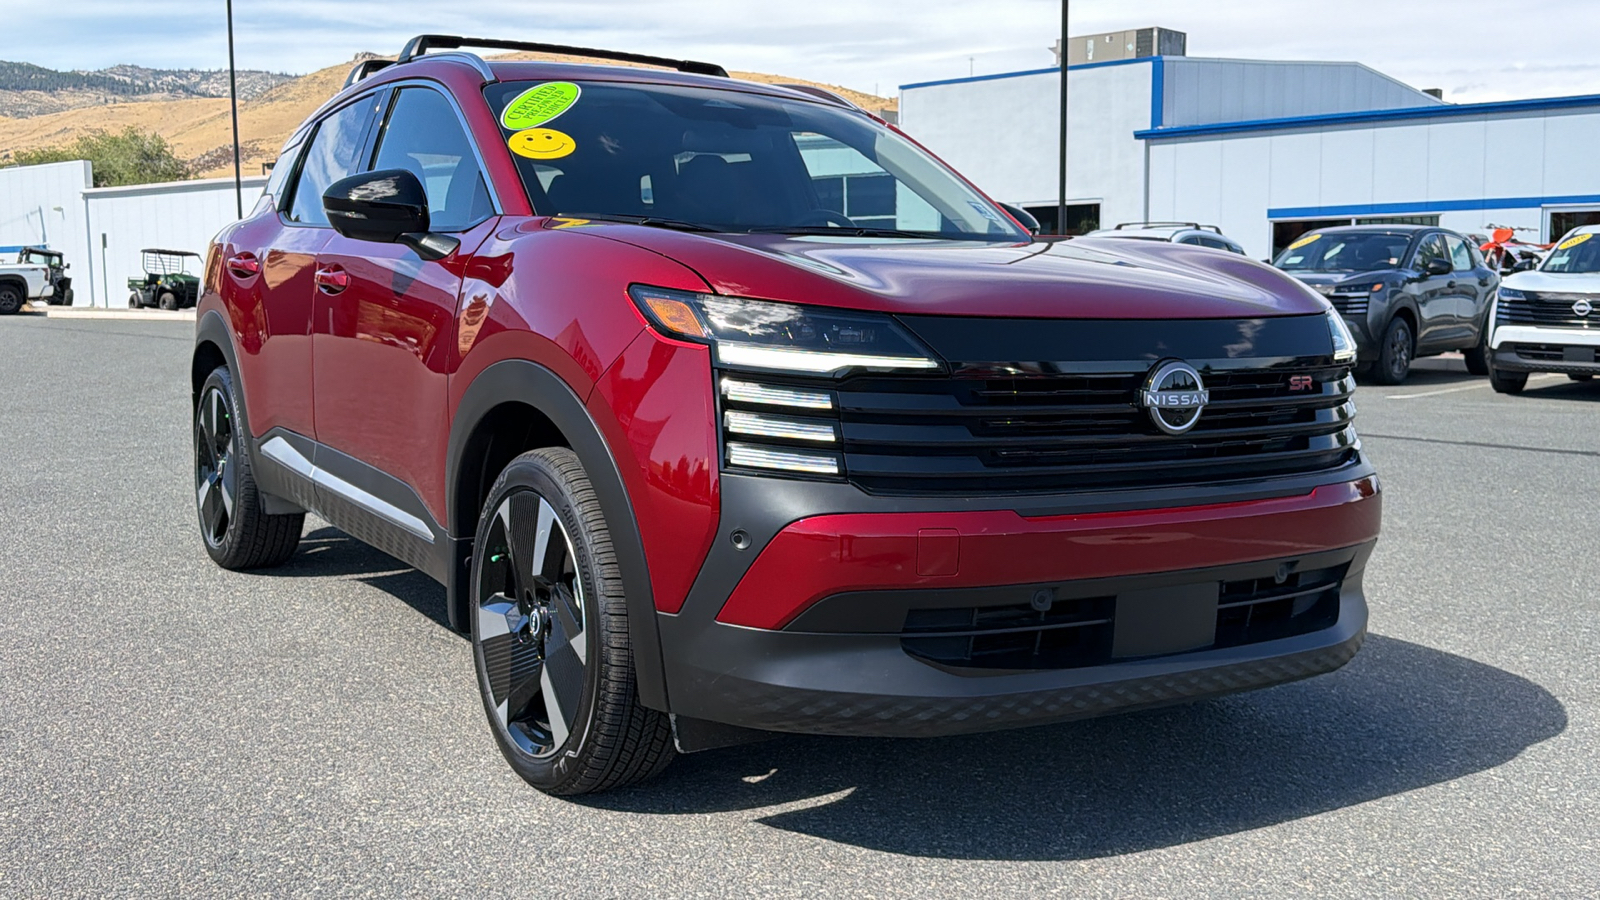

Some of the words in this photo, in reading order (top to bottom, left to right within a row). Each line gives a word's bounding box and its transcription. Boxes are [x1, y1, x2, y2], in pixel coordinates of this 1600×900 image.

[507, 85, 557, 120] CERTIFIED
[523, 90, 565, 120] PRE-OWNED
[538, 96, 571, 117] VEHICLE
[1289, 375, 1313, 391] SR
[1147, 393, 1209, 406] NISSAN
